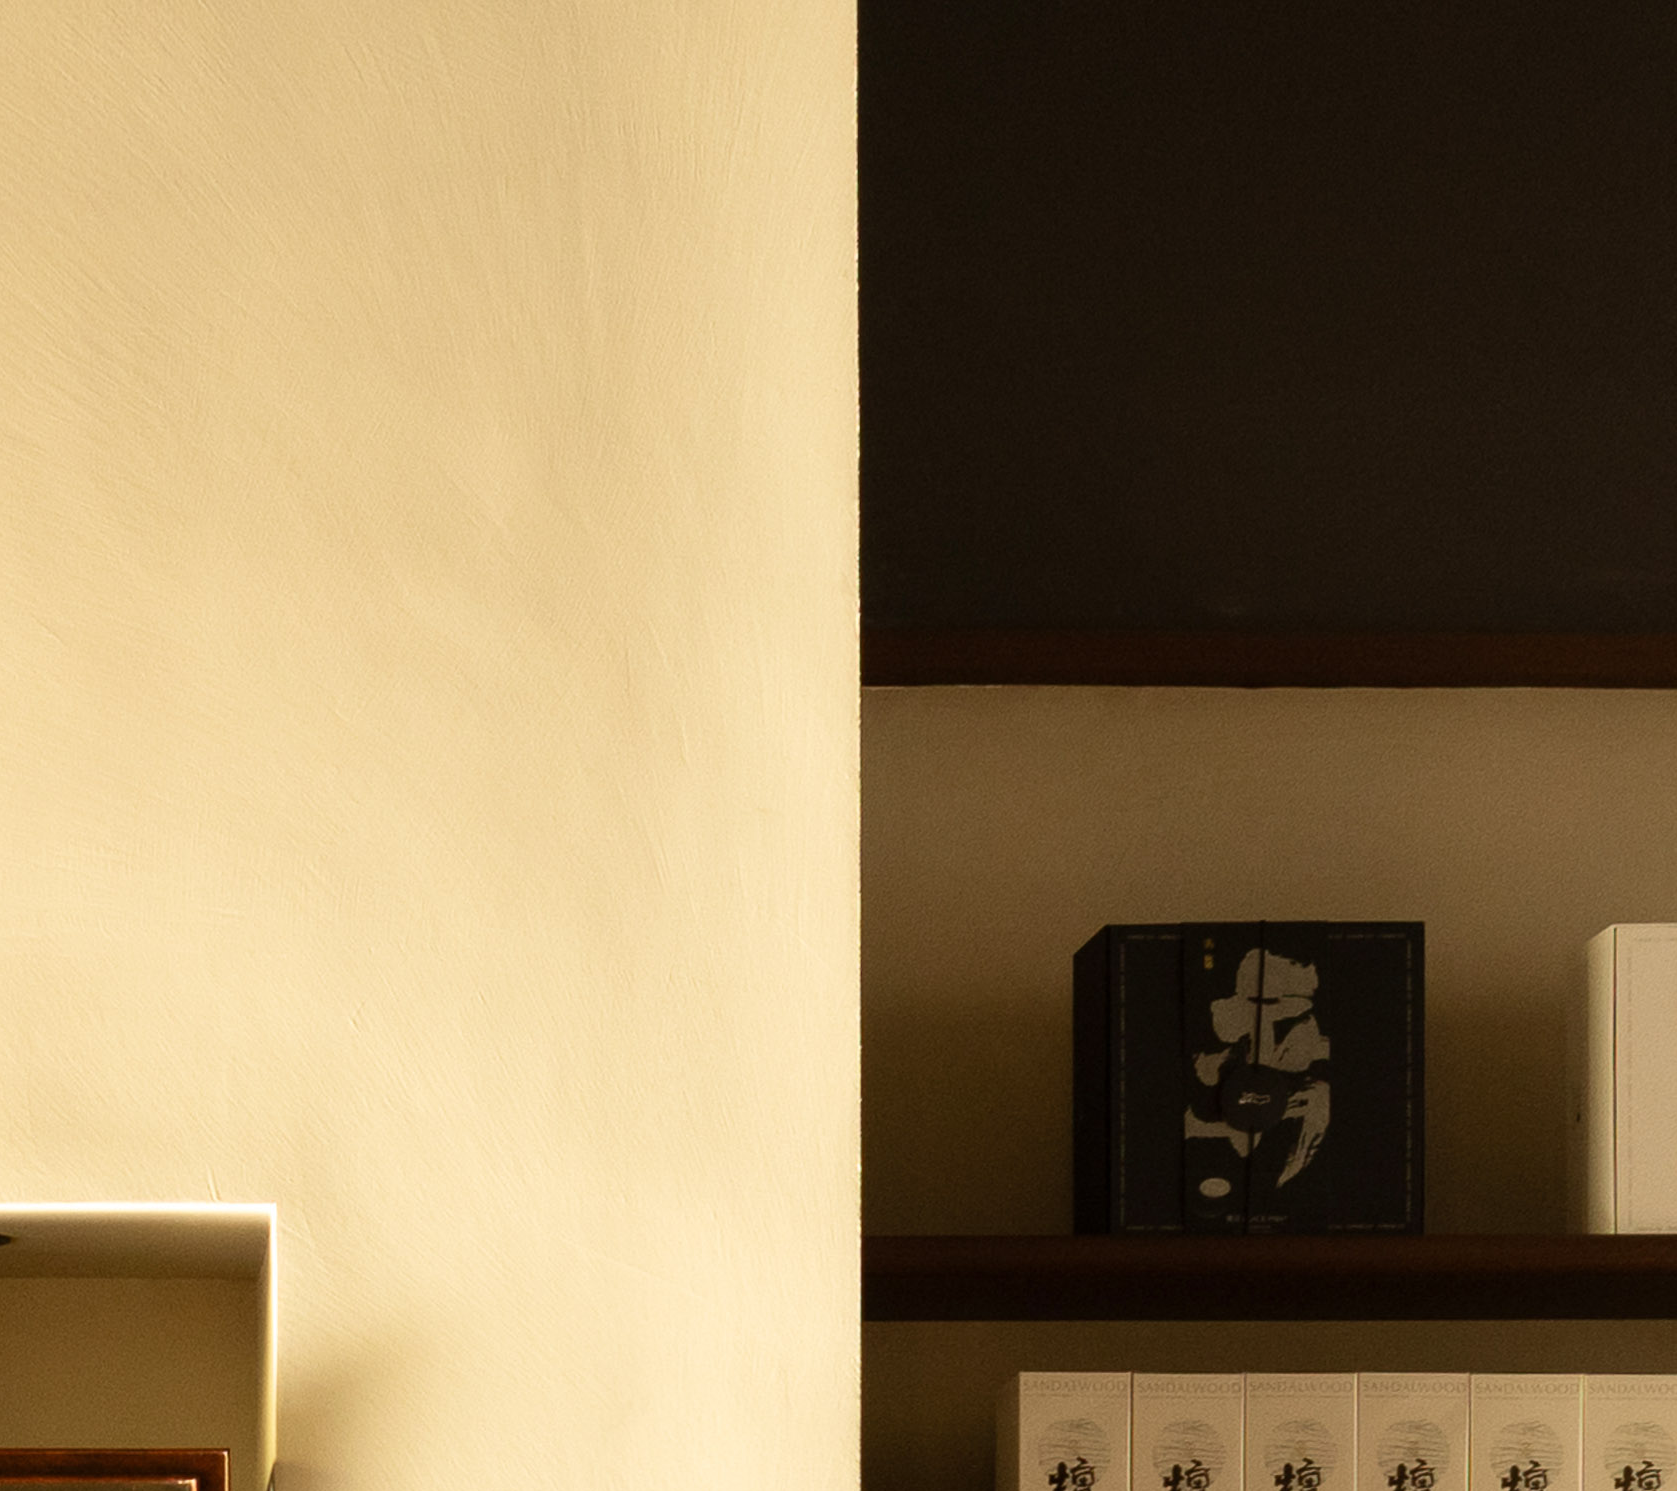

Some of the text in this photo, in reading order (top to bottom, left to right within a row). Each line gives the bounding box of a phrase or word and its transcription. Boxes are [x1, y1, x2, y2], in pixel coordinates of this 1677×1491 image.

[1023, 1380, 1127, 1395] SANDALWOOD
[1137, 1380, 1243, 1396] SANDALWOOD
[1248, 1380, 1353, 1396] SANDALWOOD
[1362, 1380, 1468, 1396] SANDALWOOD
[1475, 1382, 1580, 1396] SANDALWOOD
